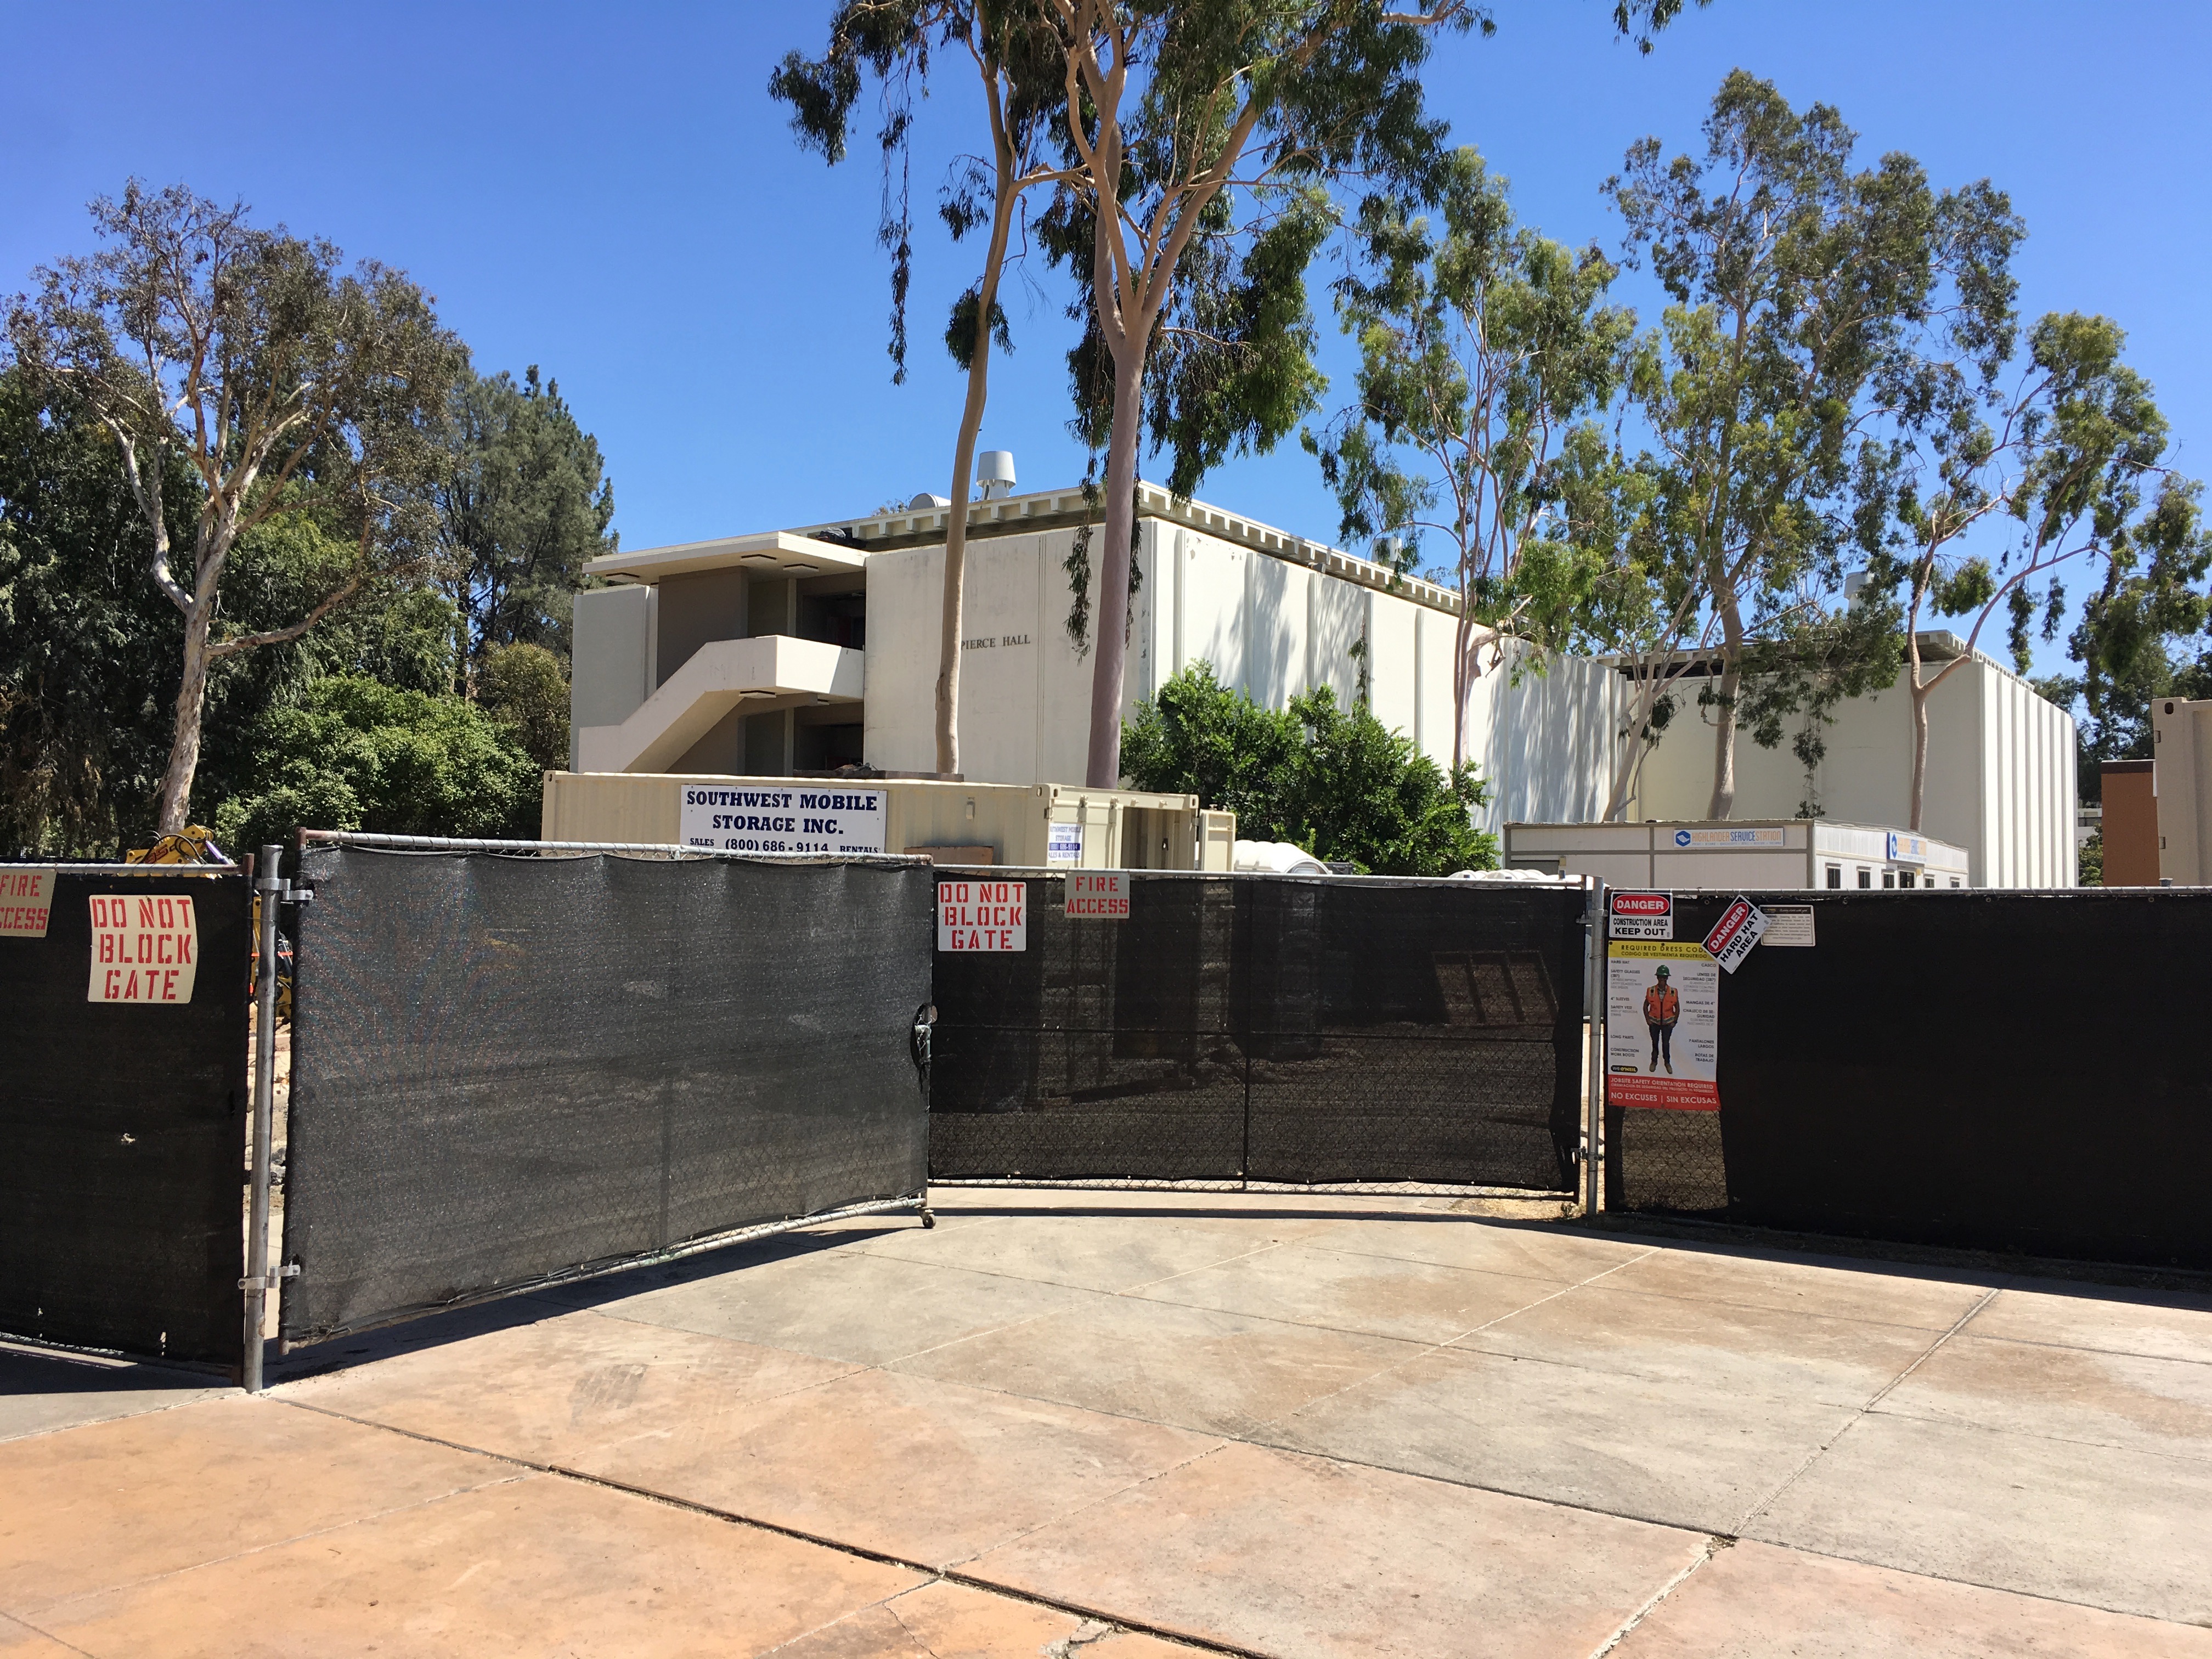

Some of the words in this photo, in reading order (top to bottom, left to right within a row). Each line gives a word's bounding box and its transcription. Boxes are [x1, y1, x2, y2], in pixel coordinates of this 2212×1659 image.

[961, 638, 996, 650] PIERCE
[1002, 635, 1030, 646] HALL
[687, 791, 792, 808] SOUTHWEST
[800, 794, 877, 811] MOBILE
[713, 815, 795, 832] STORAGE
[803, 819, 843, 834] INC.
[690, 838, 714, 846] SALES
[725, 839, 759, 851] (800)
[0, 874, 42, 896] FIRE
[1076, 876, 1118, 891] FIRE
[940, 884, 968, 903] DO
[980, 884, 1024, 902] NOT
[92, 899, 128, 928] DO
[138, 899, 190, 928] NOT
[1066, 899, 1128, 913] ACCESS
[1617, 900, 1664, 910] DANGER
[945, 907, 1022, 926] BLOCK
[1613, 918, 1652, 927] CONSTRUCTION
[1615, 927, 1641, 935] KEEP
[1644, 928, 1666, 936] OUT
[1710, 906, 1746, 950] DANGER
[1720, 935, 1742, 962] HARD
[1741, 913, 1758, 934] HAT
[99, 934, 191, 964] BLOCK
[952, 930, 1012, 949] GATE
[1736, 930, 1758, 958] AREA
[104, 970, 179, 1000] GATE
[1625, 1093, 1657, 1102] EXCUSES
